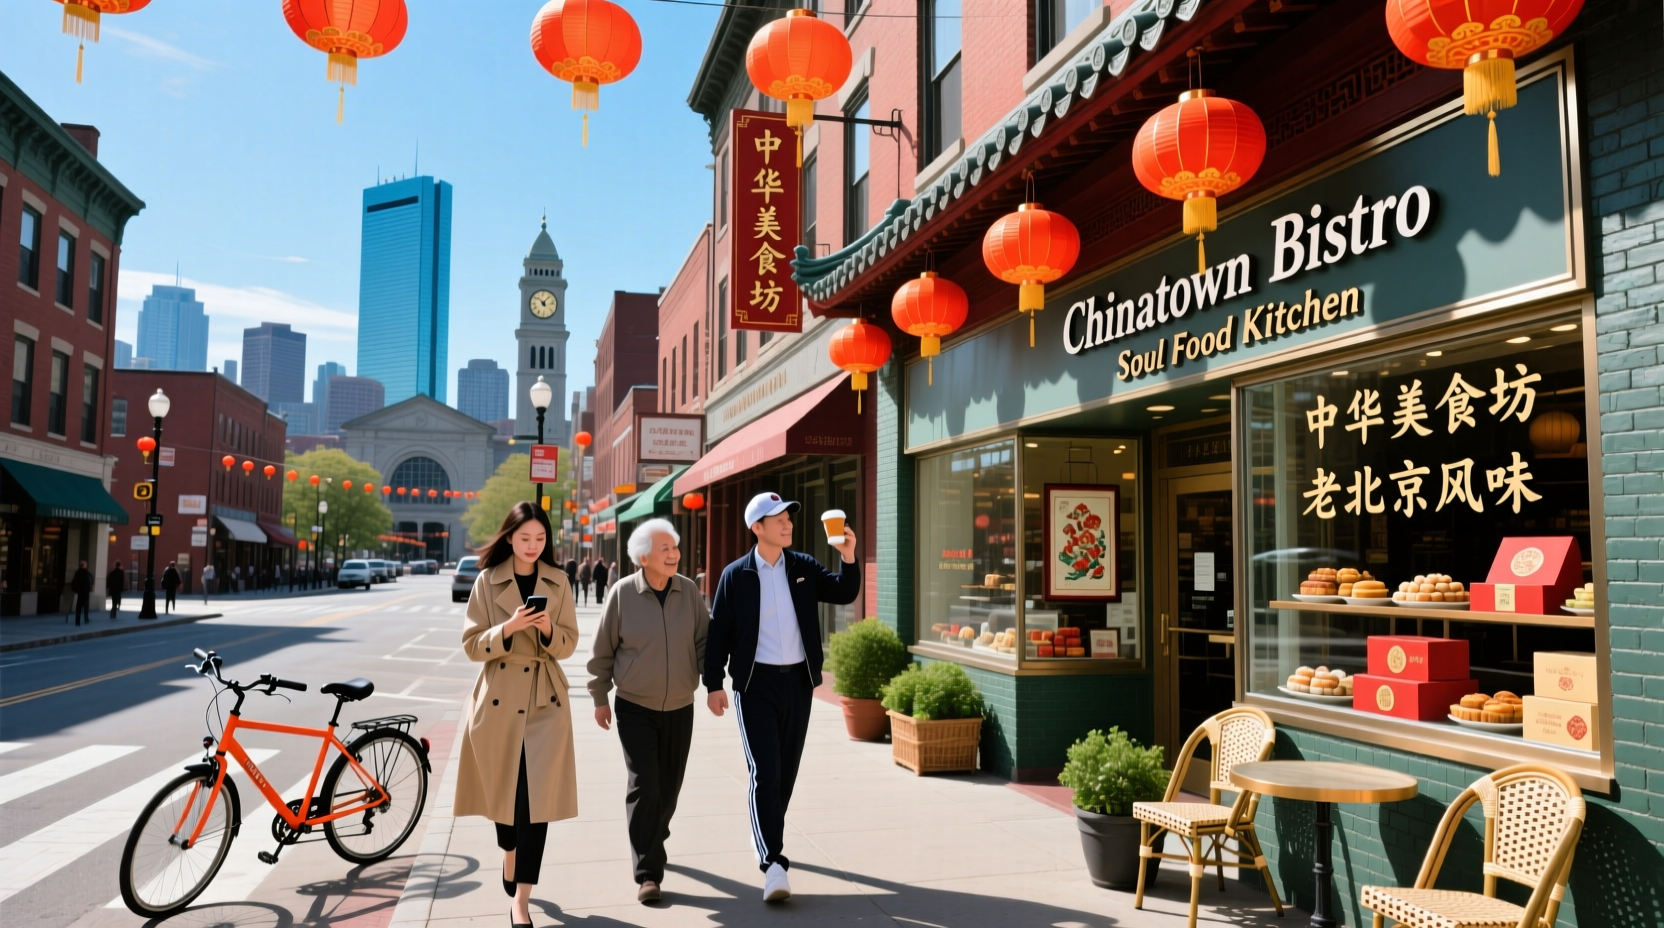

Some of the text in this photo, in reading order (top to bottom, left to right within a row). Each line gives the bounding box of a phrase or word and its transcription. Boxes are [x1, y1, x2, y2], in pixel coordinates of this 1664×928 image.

[749, 129, 786, 313] 中华美食坊
[1062, 185, 1431, 355] Chinatown Bistro
[1116, 286, 1360, 381] Soul Food Kitchen
[1305, 363, 1542, 449] 中华美食坊
[1302, 451, 1542, 519] 老北京风味
